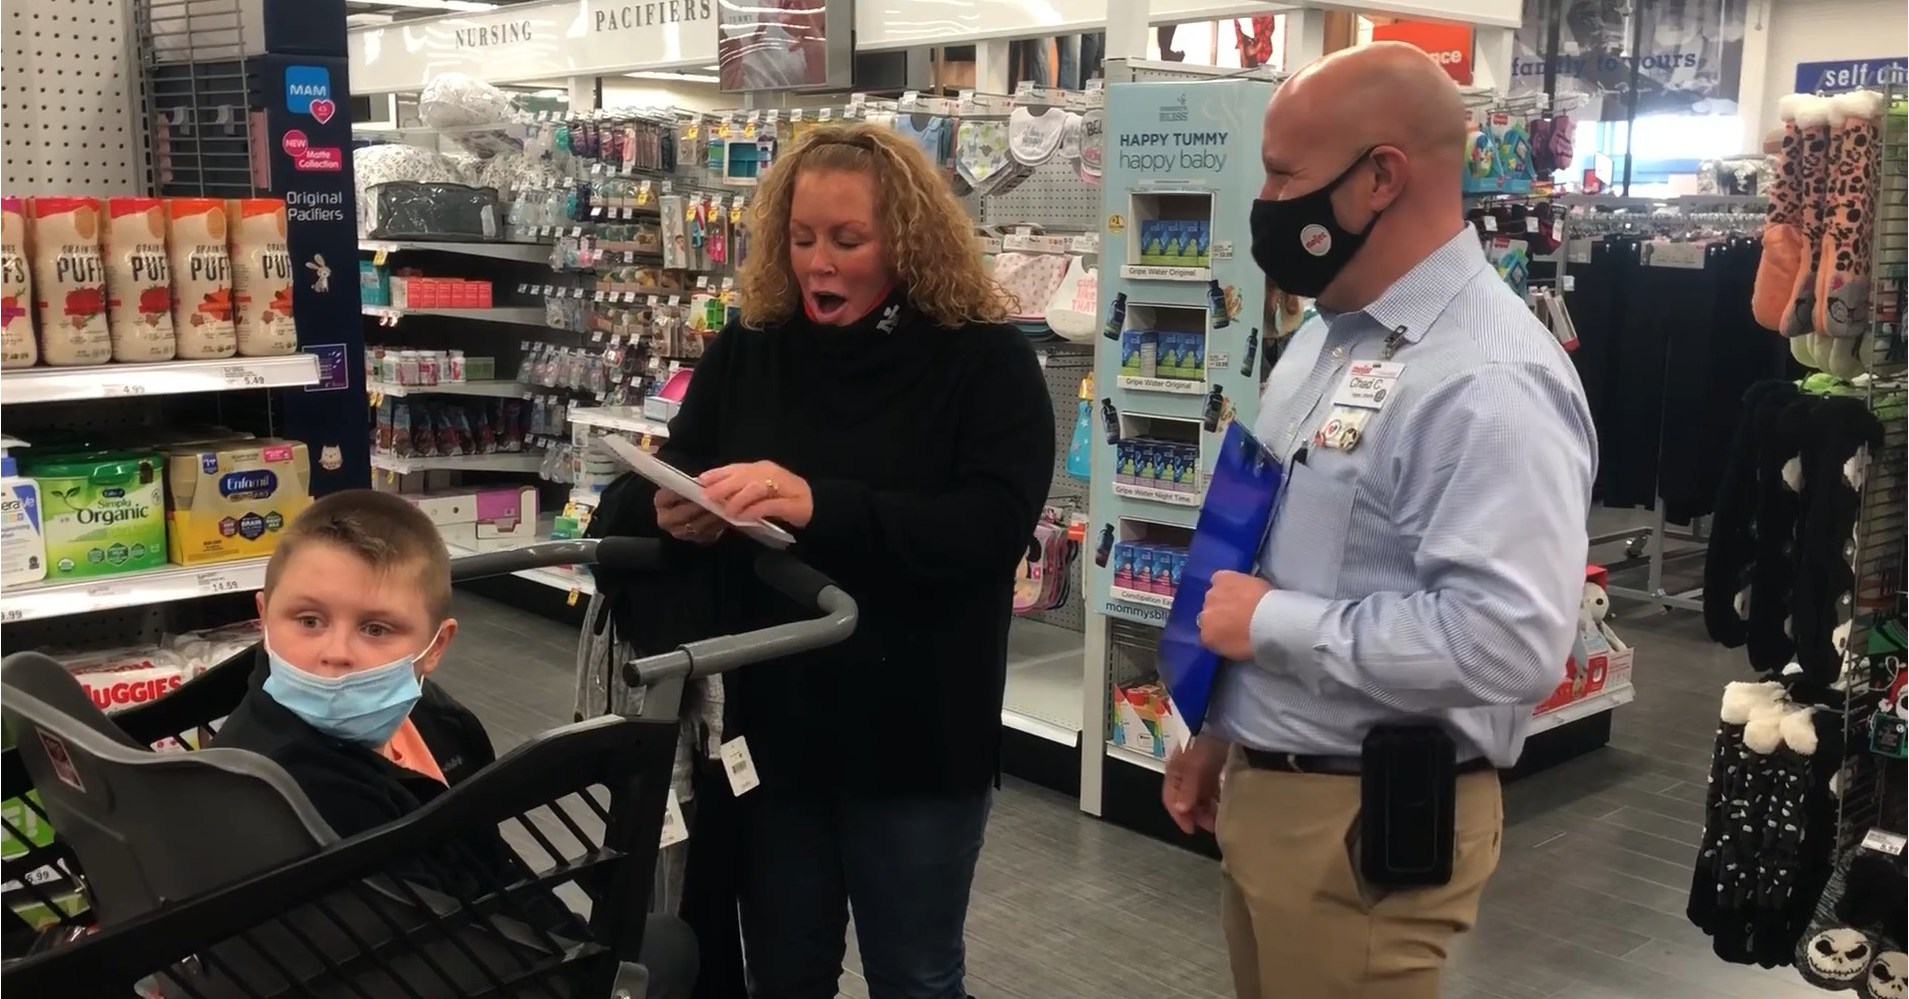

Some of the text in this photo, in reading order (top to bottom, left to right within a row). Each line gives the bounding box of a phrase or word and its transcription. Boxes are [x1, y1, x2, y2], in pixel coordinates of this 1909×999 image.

[595, 0, 711, 32] PACIFIERS
[455, 20, 533, 49] NURSING
[1634, 53, 1697, 71] ours
[1825, 63, 1868, 87] self
[289, 84, 327, 97] MAM
[285, 138, 307, 148] NEW
[1119, 131, 1229, 147] HAPPY TUMMY
[306, 150, 331, 159] Matte
[1119, 149, 1177, 173] happy
[1179, 148, 1228, 173] baby
[298, 159, 340, 169] Collection
[286, 190, 343, 207] Original
[287, 207, 344, 222] Pacifiers
[1129, 267, 1197, 278] Gripe Water Original
[244, 376, 265, 386] 5.49
[1126, 377, 1192, 390] Gripe Water Original
[123, 384, 145, 394] 4.99
[226, 474, 270, 491] Enfamil
[1115, 485, 1191, 502] Gripe Water Night Time
[98, 499, 132, 510] Simply
[77, 505, 149, 526] Organic
